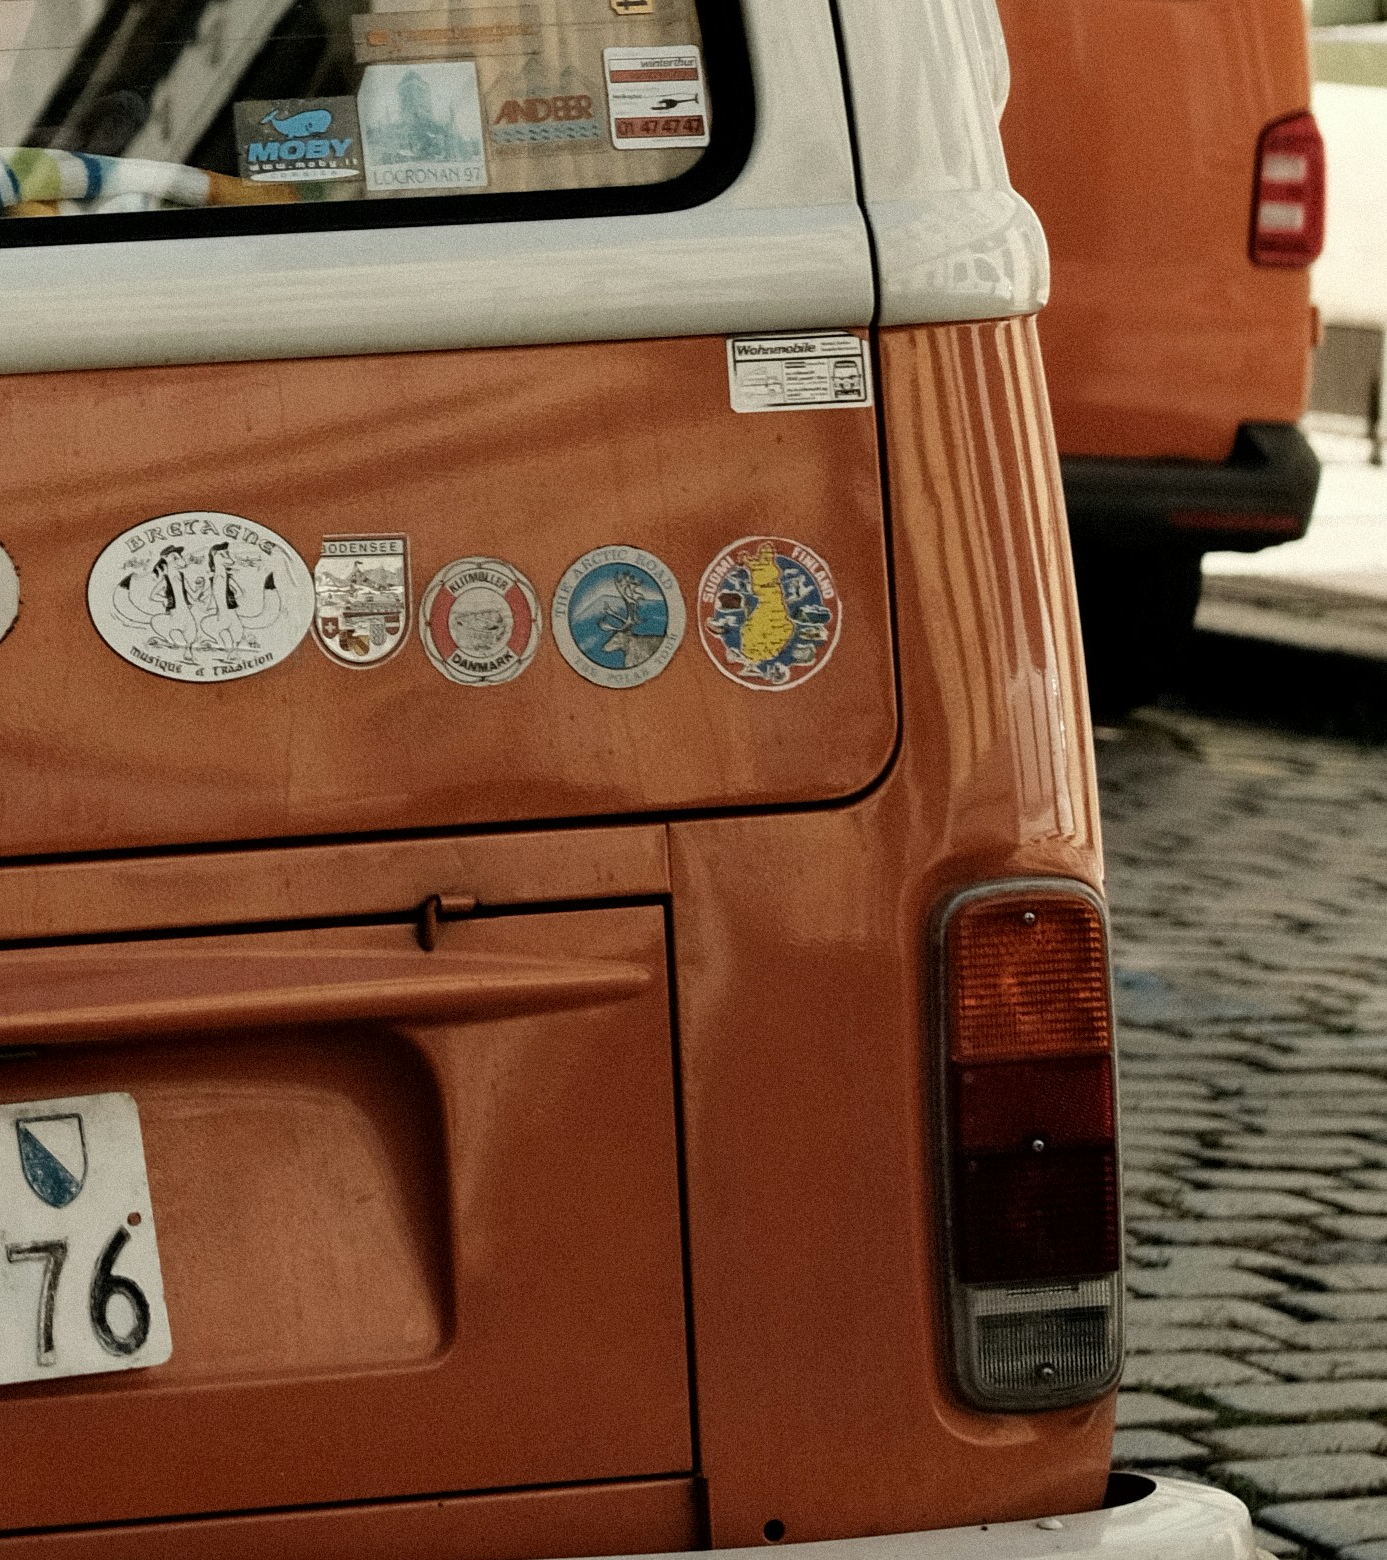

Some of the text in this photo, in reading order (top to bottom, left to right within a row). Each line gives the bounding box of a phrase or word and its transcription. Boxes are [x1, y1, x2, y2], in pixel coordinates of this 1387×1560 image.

[247, 137, 354, 162] MOBY
[248, 157, 359, 172] www.moby.it
[373, 168, 461, 187] LOCRONAN
[736, 342, 816, 356] Wohnmobile
[573, 548, 628, 577] ARCTIC
[791, 545, 835, 600] FINLAND
[702, 555, 736, 604] SUOMI
[451, 651, 515, 673] DANMARK
